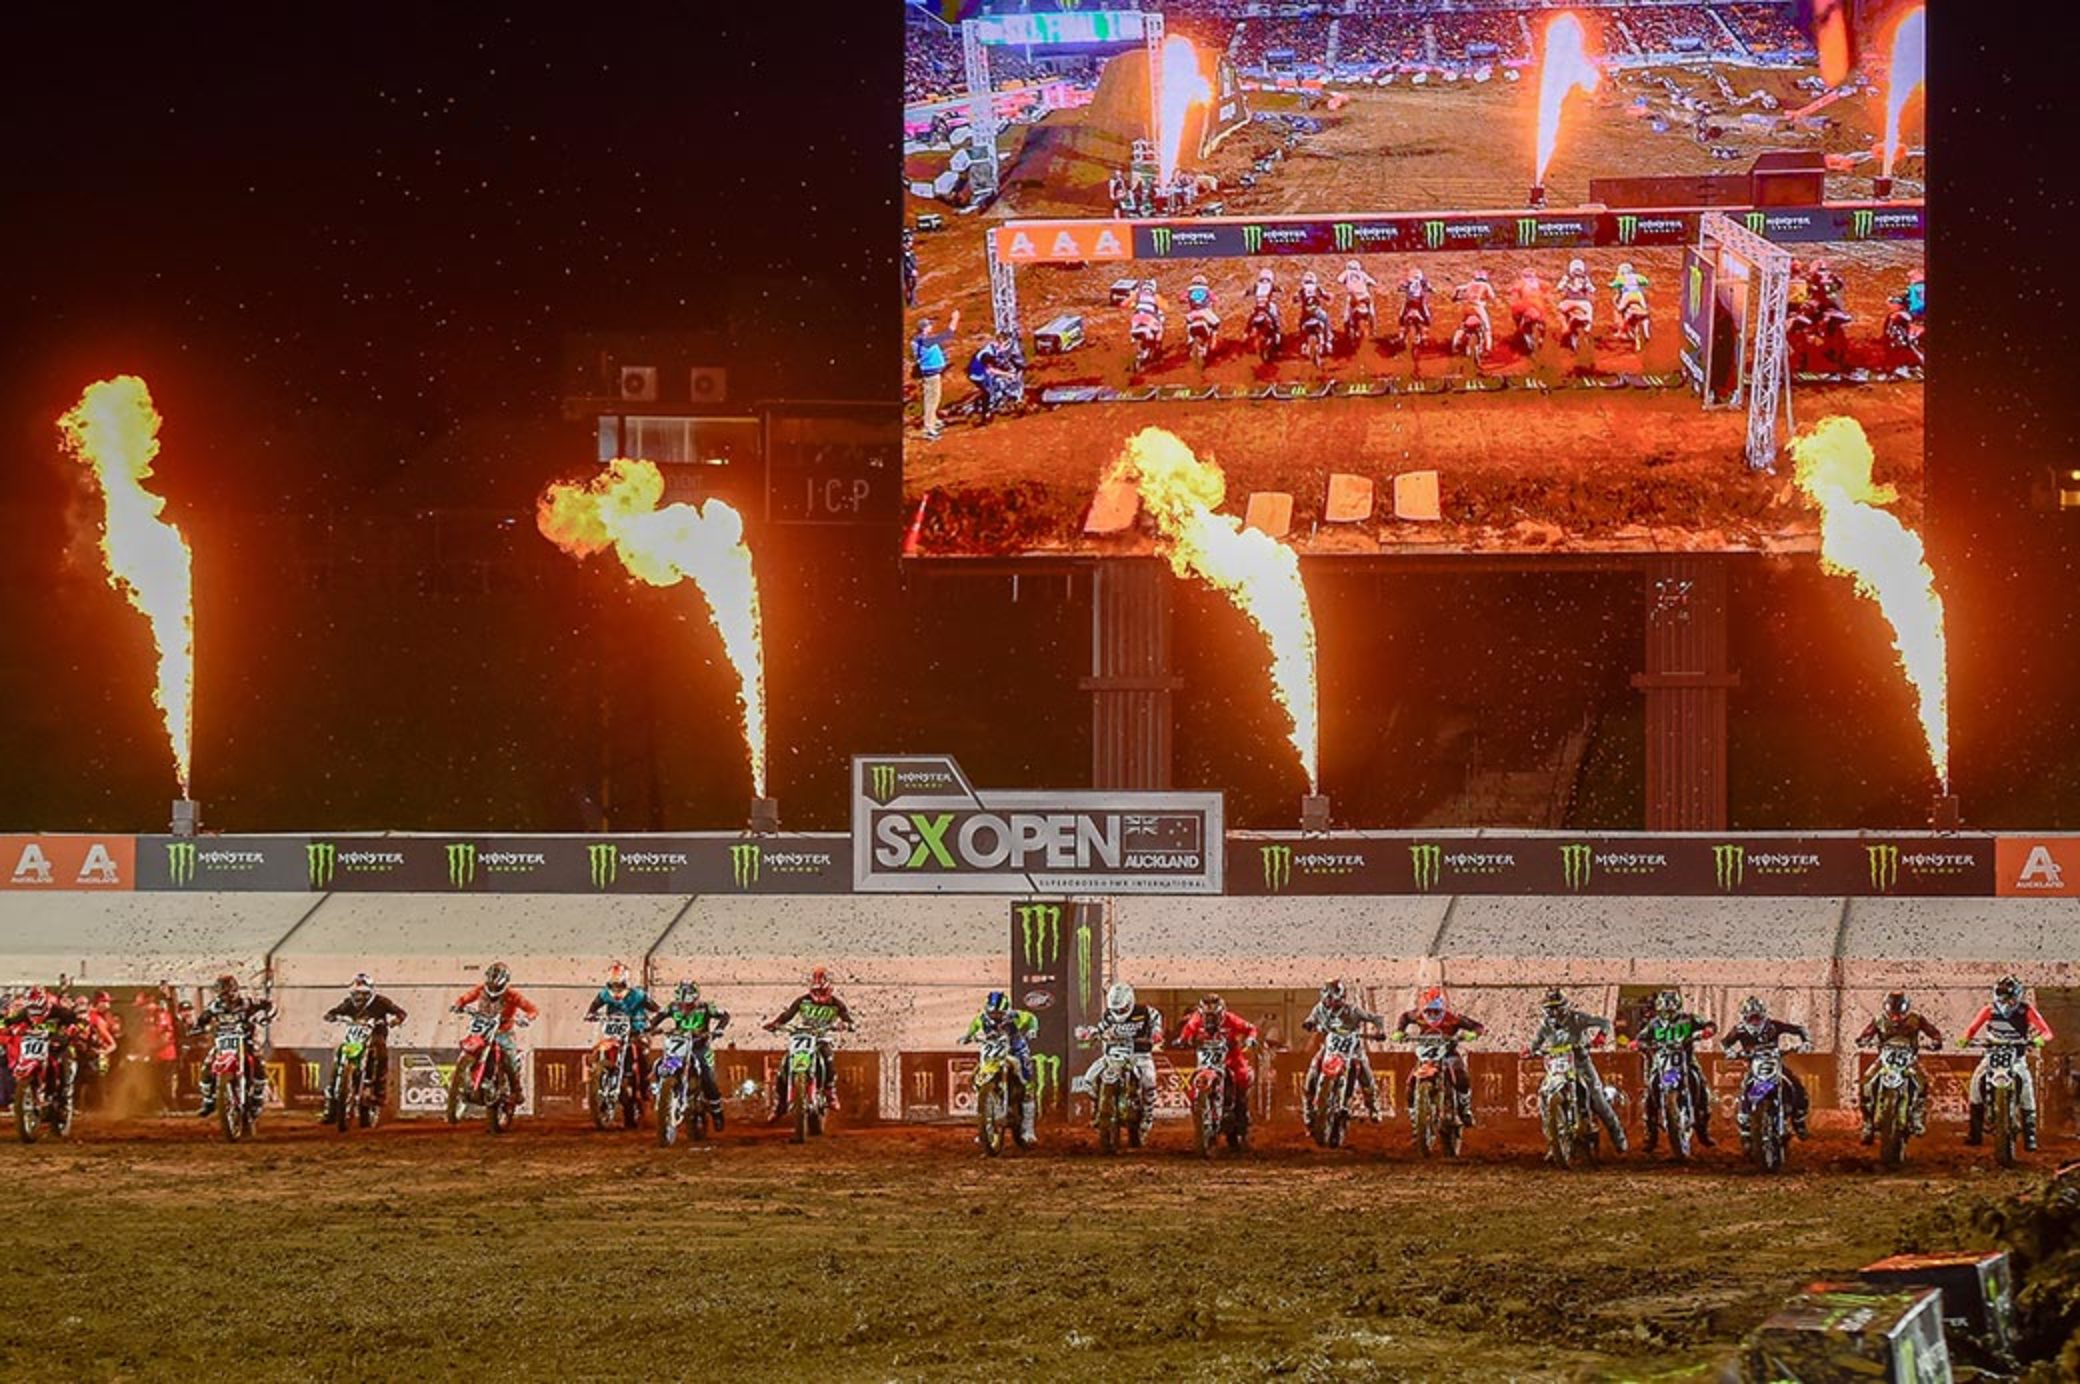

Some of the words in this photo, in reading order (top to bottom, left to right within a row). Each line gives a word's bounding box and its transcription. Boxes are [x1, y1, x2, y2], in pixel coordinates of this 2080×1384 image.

[198, 851, 264, 864] MONSTER
[337, 852, 404, 864] MONSTER
[478, 852, 545, 864] MONSTER
[620, 853, 687, 865] MONSTER
[763, 853, 831, 866] MONSTER
[1124, 855, 1199, 868] AUCKLAND
[1294, 853, 1365, 866] MONSTER
[1444, 853, 1515, 866] MONSTER
[1595, 853, 1667, 866] MONSTER
[1748, 853, 1820, 867] MONSTER
[1901, 853, 1975, 866] MONSTER
[25, 1042, 43, 1055] 10
[670, 1038, 685, 1053] 7
[793, 1037, 812, 1049] 71
[1990, 1052, 2012, 1069] 88
